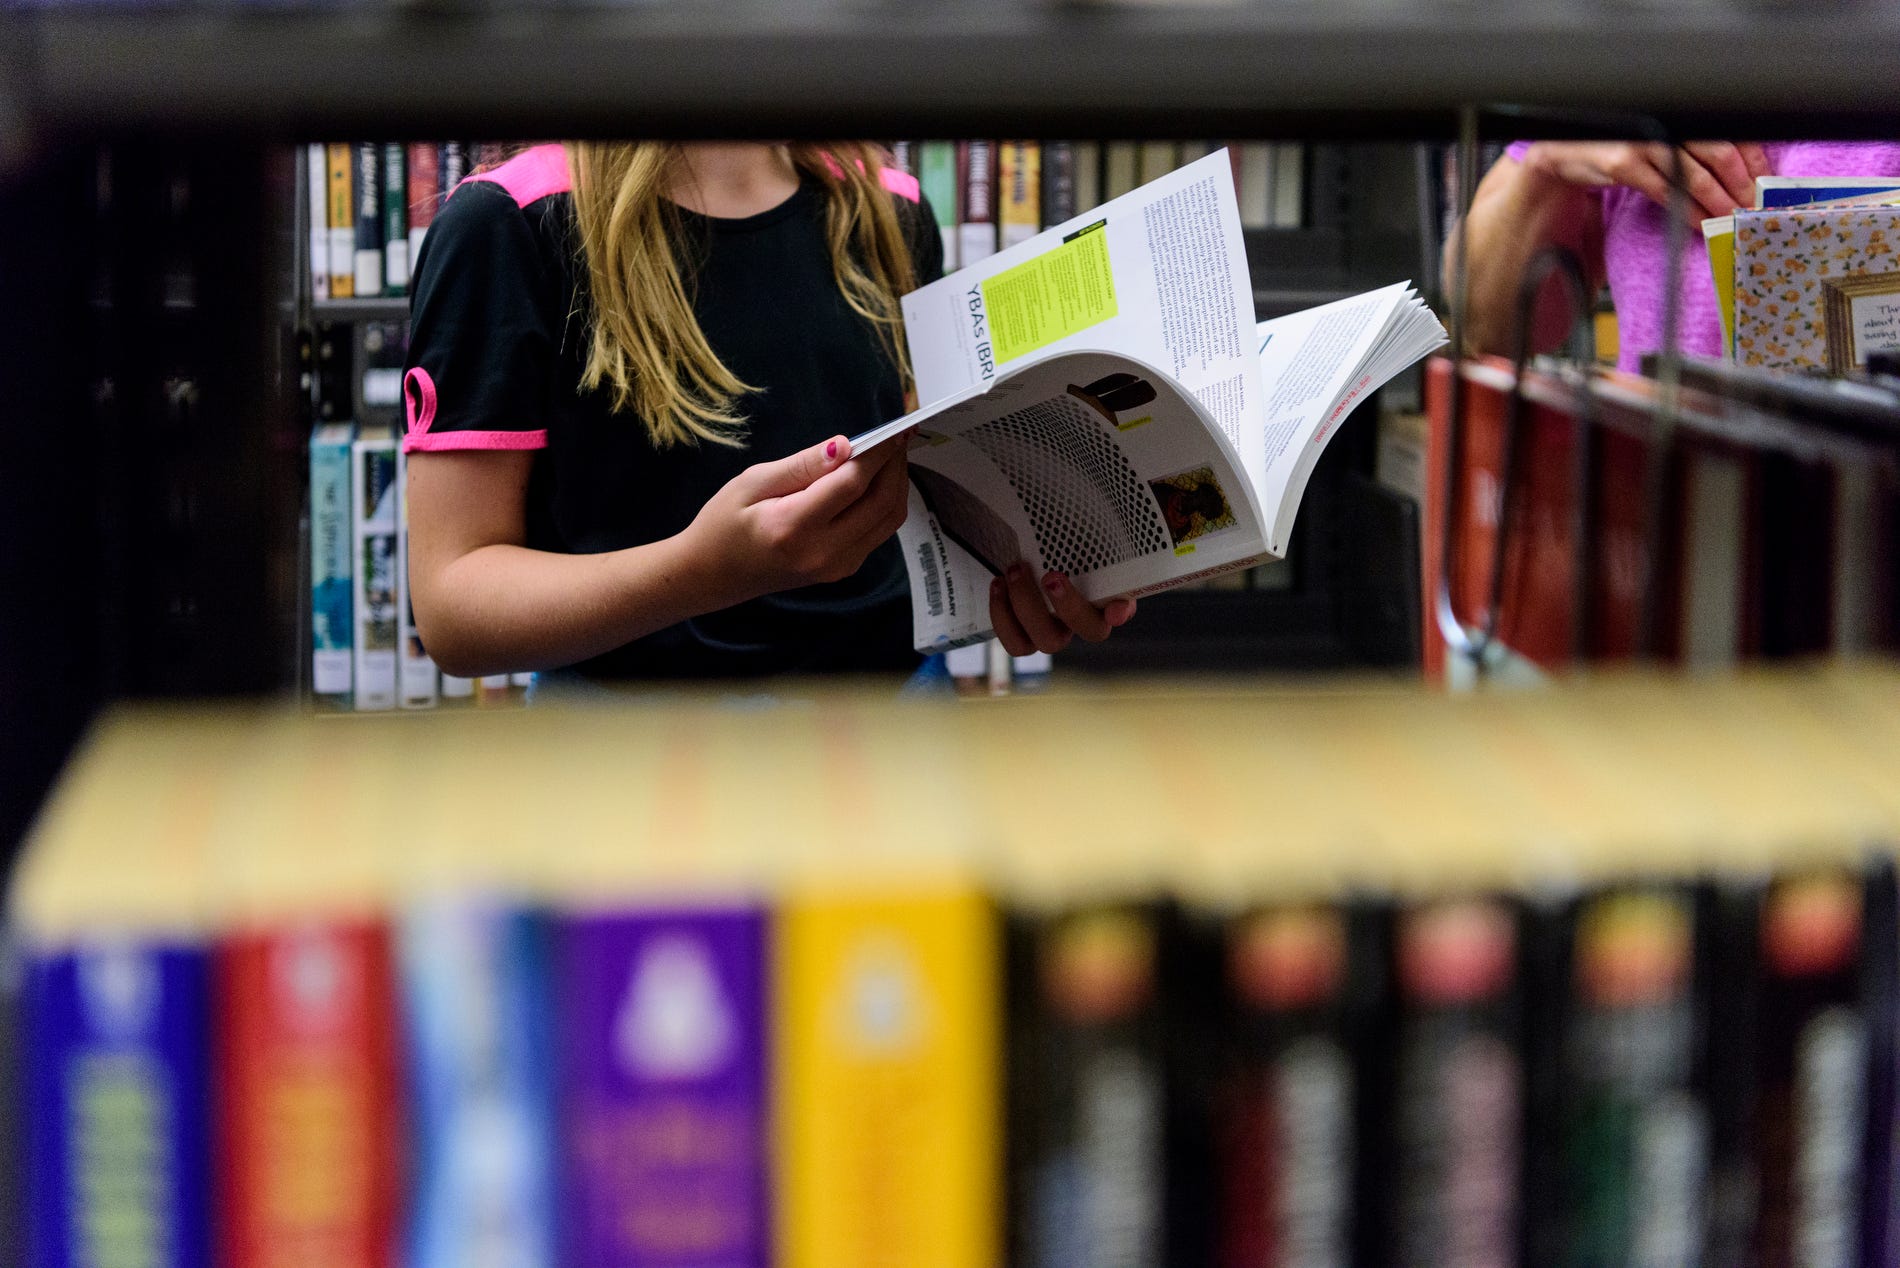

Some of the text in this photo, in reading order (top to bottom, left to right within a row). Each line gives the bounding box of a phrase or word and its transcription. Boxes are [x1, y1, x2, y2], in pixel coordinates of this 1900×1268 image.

[966, 283, 985, 339] YBAs
[929, 519, 956, 617] CENTRAL LIBRARY
